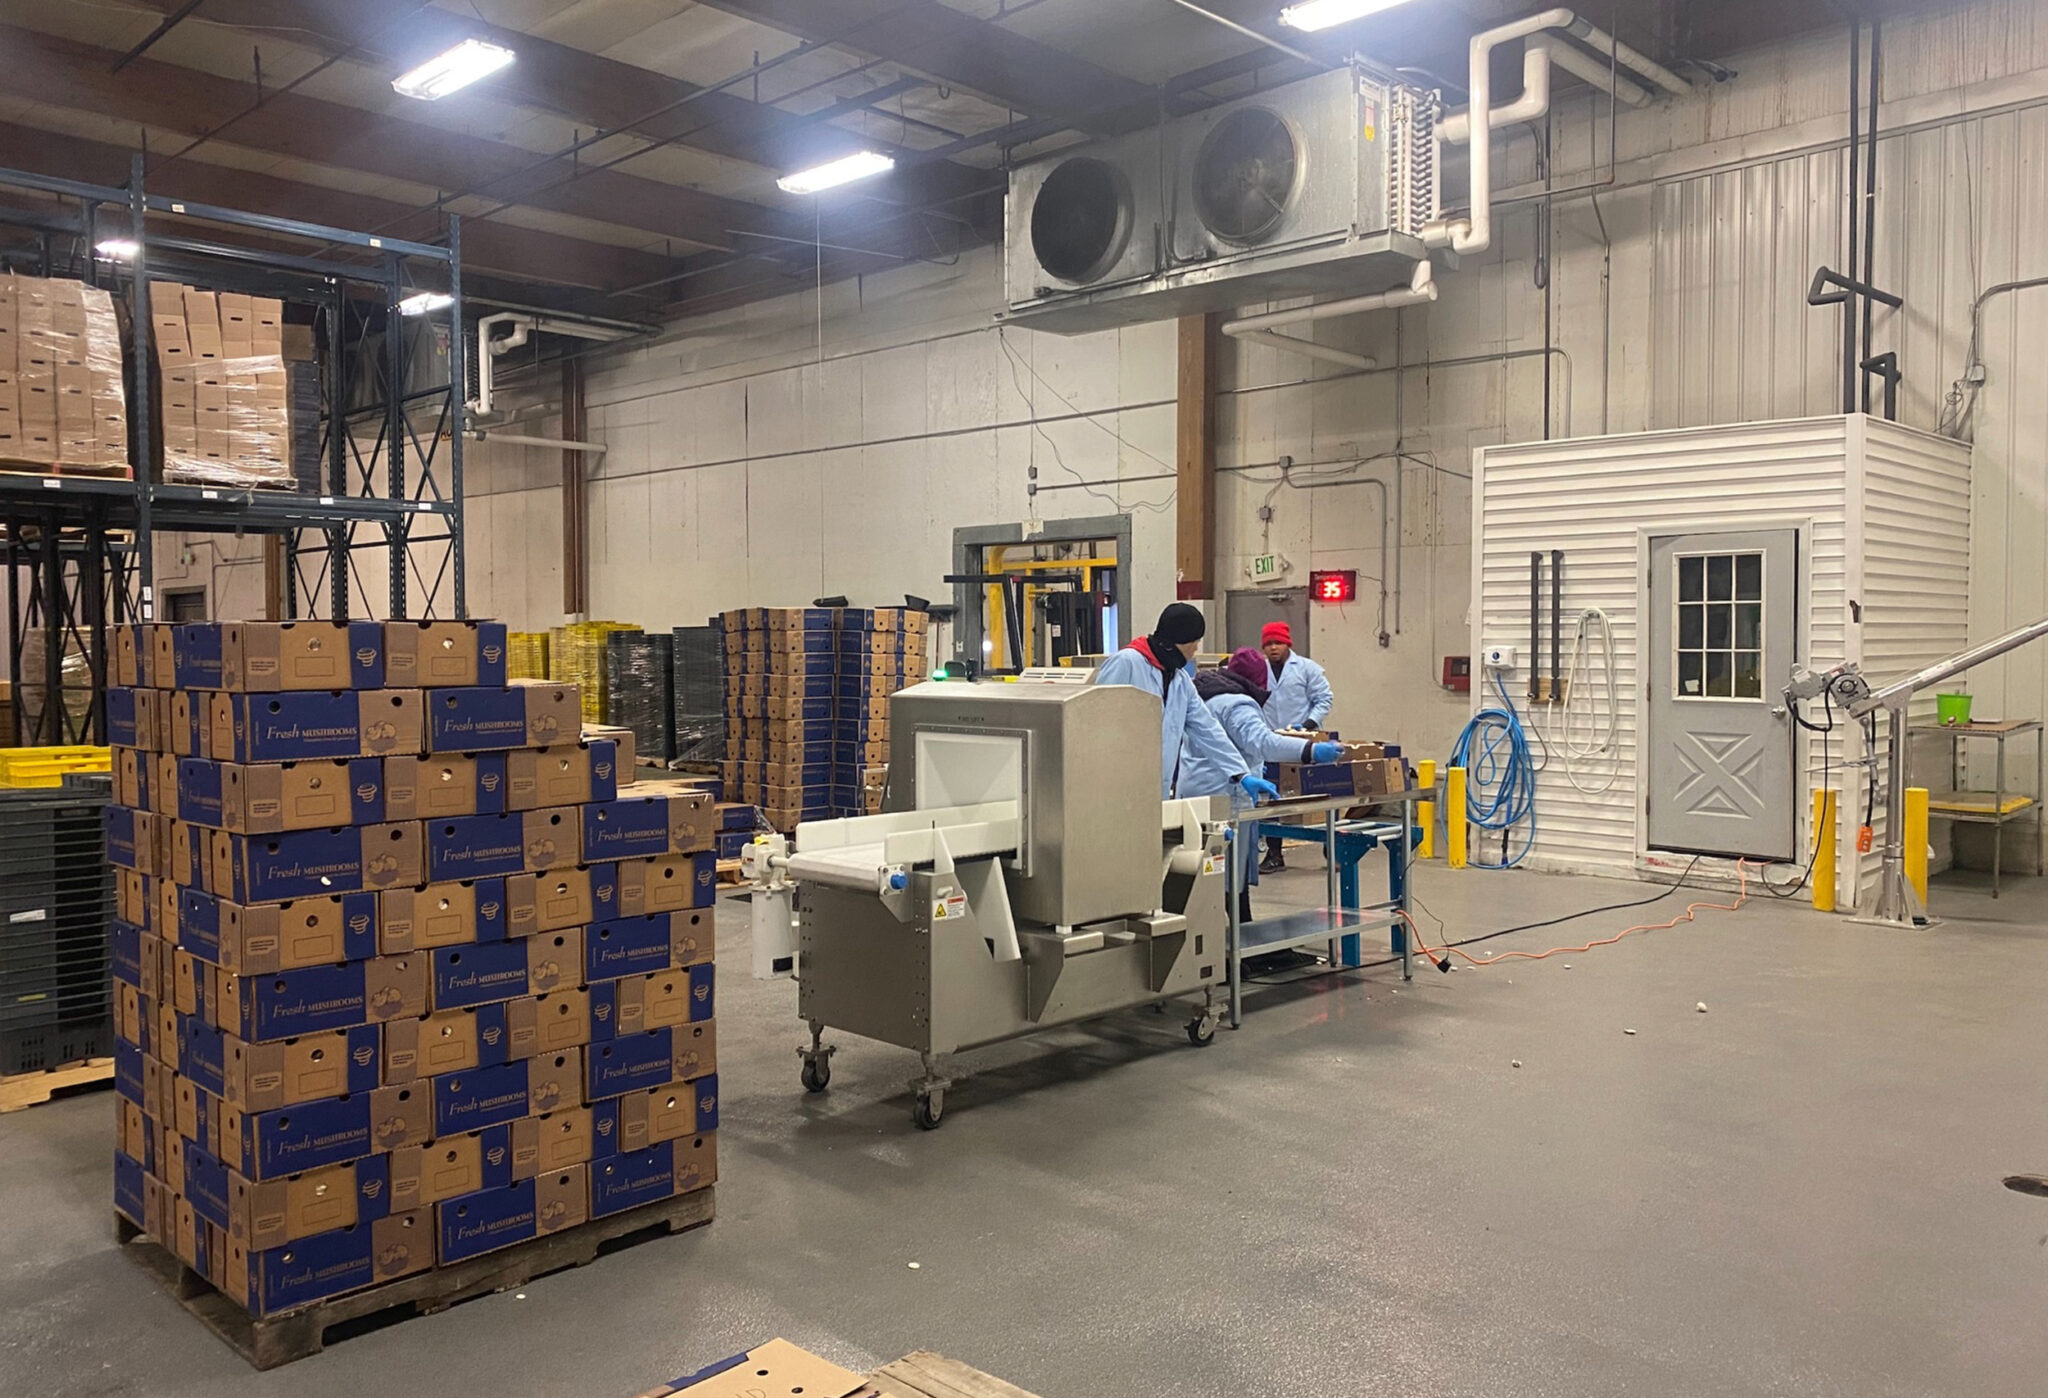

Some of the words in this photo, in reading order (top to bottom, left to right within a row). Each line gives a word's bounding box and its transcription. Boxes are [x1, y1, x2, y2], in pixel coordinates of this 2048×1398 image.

[1255, 555, 1274, 574] EXIT
[1323, 581, 1341, 598] 35
[267, 723, 300, 739] Fresh
[302, 728, 358, 737] MUSHROOMS
[444, 717, 473, 732] Fresh
[475, 720, 523, 729] MUSHROOMS
[597, 827, 623, 842] Fresh
[443, 845, 471, 862] Fresh
[473, 845, 521, 857] MUSHROOMS
[268, 862, 301, 879] Fresh
[304, 862, 359, 874] MUSHROOMS
[601, 945, 626, 962] Fresh
[449, 971, 477, 989] Fresh
[478, 969, 526, 983] MUSHROOMS
[273, 999, 305, 1018] Fresh
[308, 996, 363, 1011] MUSHROOMS
[449, 1097, 478, 1116] Fresh
[278, 1134, 310, 1155] Fresh
